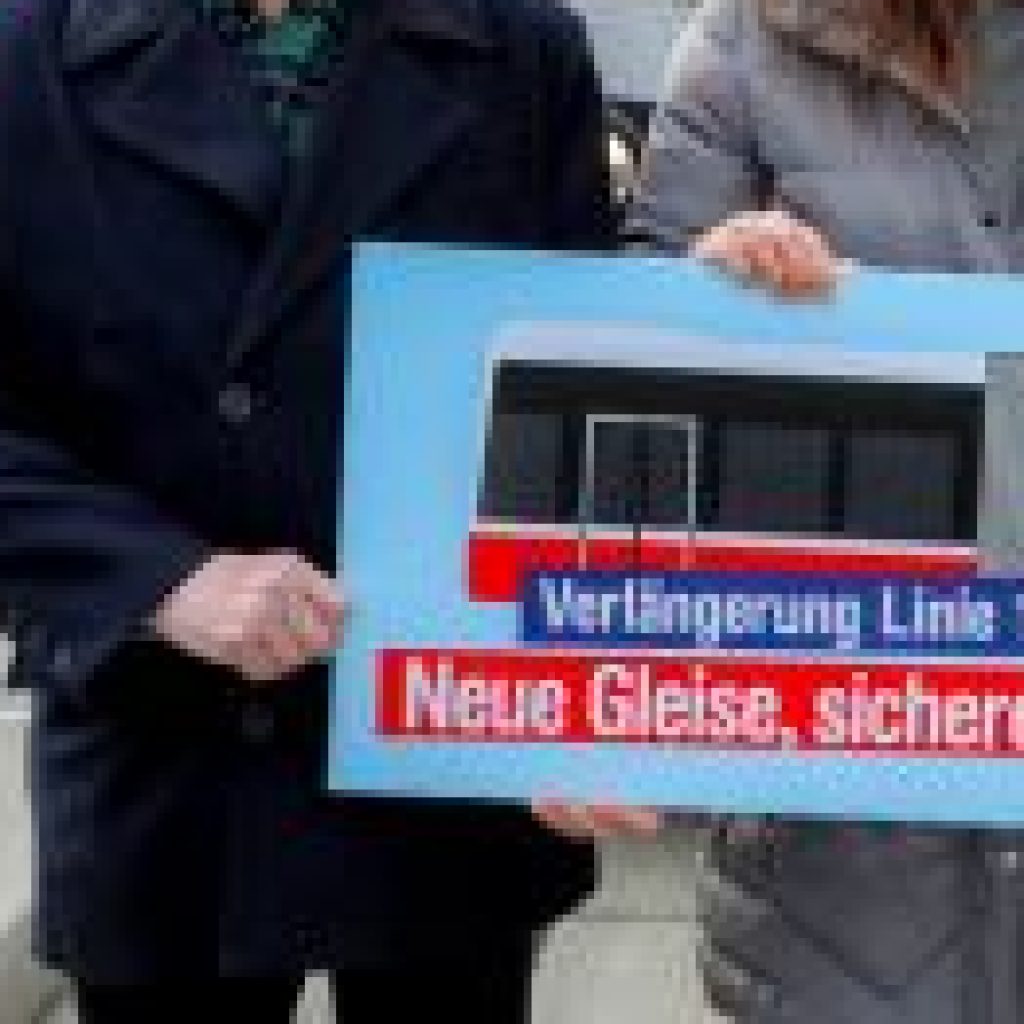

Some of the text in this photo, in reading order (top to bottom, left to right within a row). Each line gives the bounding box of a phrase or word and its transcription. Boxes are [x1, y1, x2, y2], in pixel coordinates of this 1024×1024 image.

[536, 576, 864, 650] Verlängerung
[880, 590, 996, 642] Linie
[402, 656, 568, 736] Neue
[586, 664, 800, 754] Gleise,
